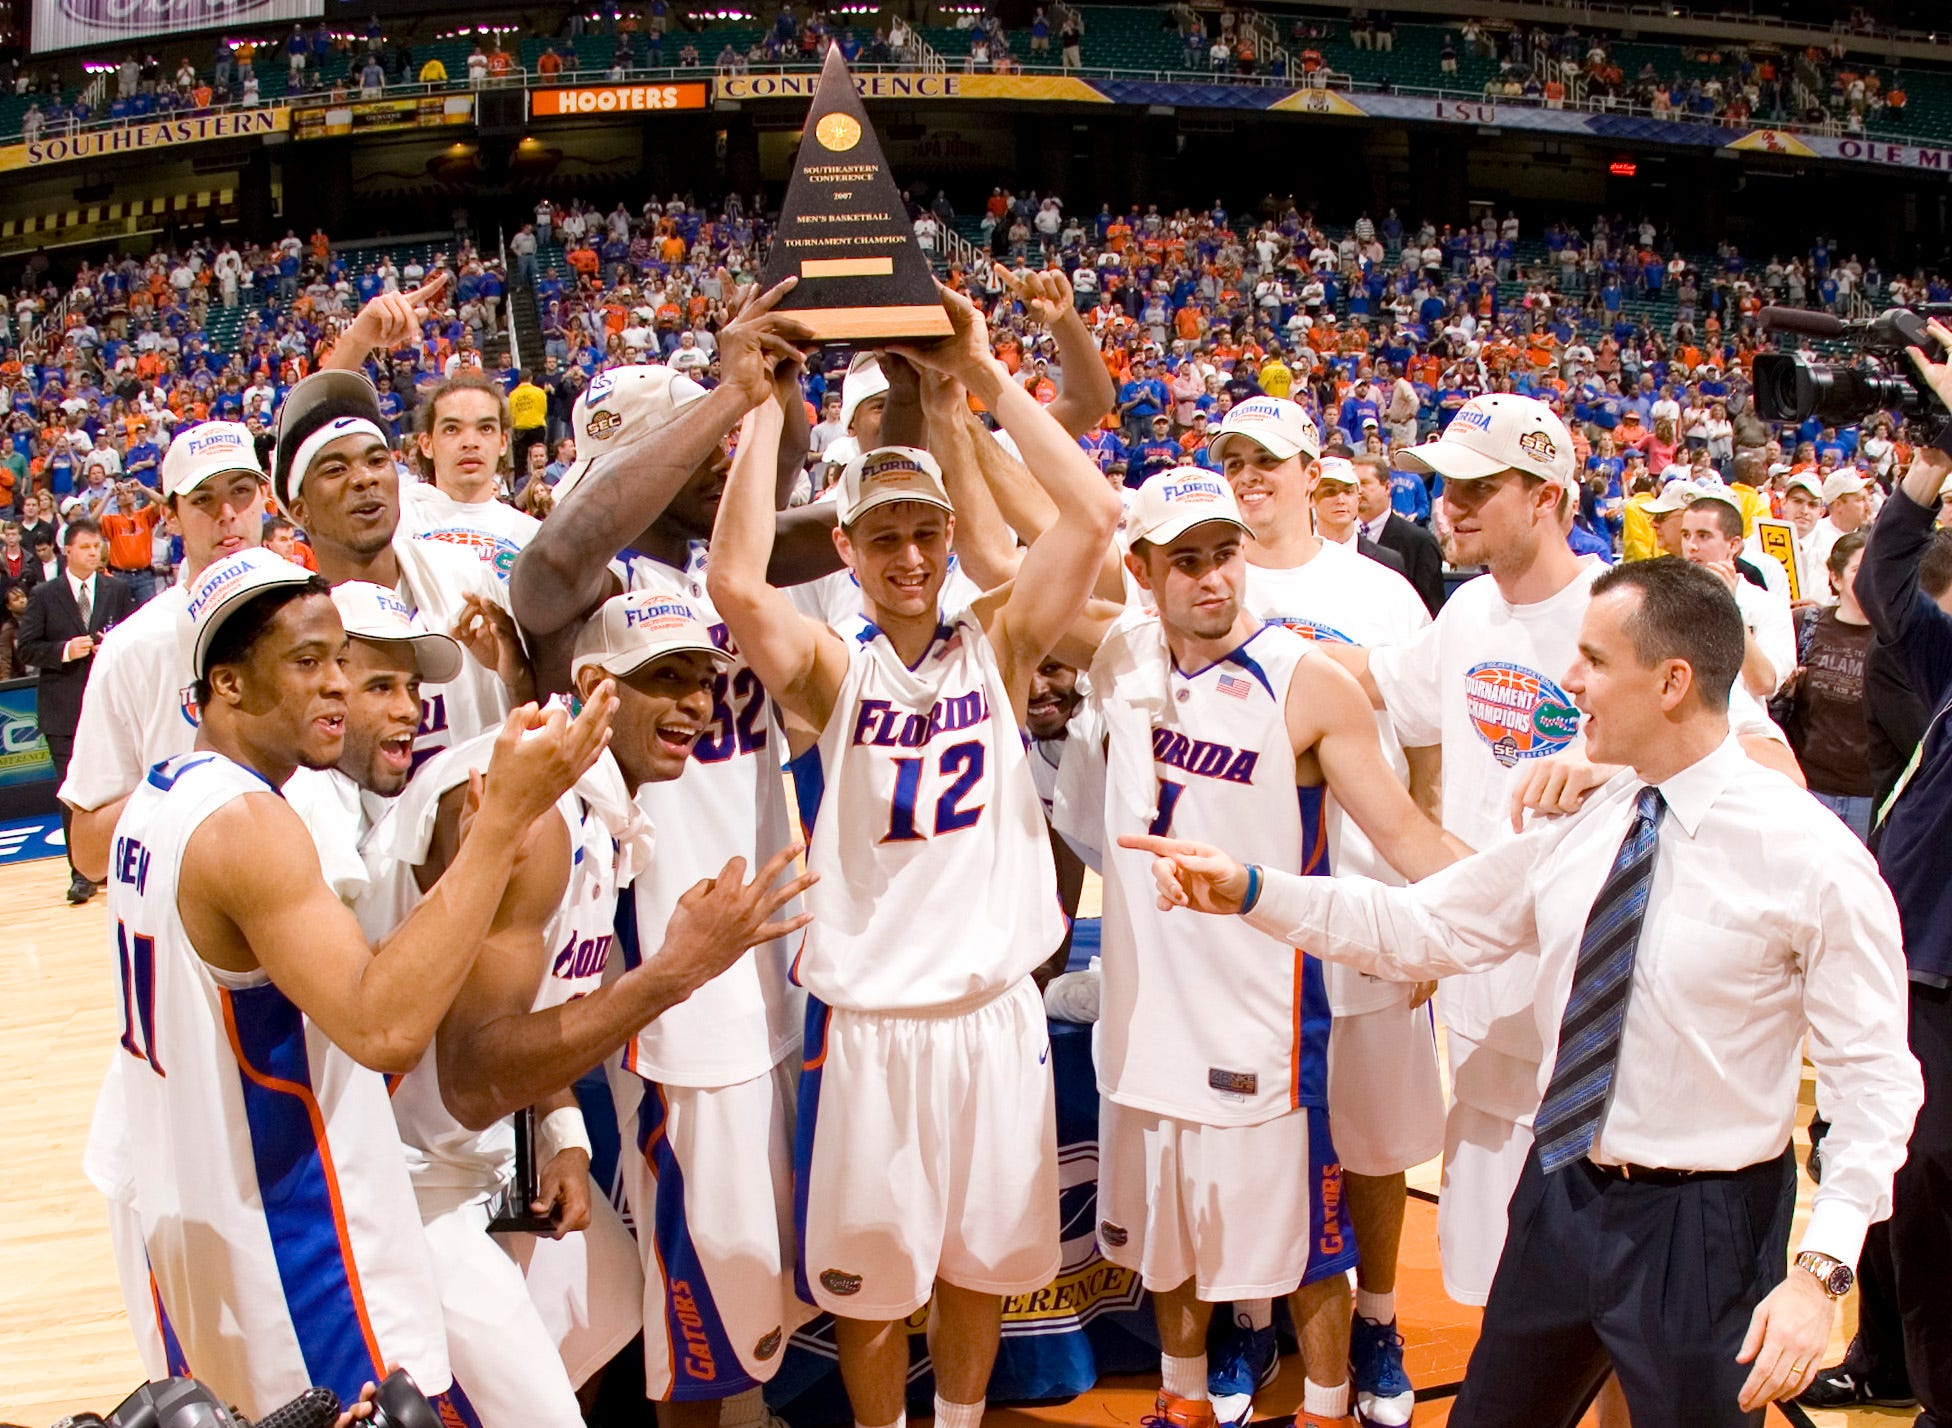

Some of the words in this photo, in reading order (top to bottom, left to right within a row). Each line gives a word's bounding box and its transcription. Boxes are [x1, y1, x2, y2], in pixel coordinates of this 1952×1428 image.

[725, 76, 960, 98] CONFRENCE
[558, 87, 678, 113] HOOTERS
[1435, 101, 1495, 123] LSU
[28, 111, 274, 164] SOUTHEASTERN
[1838, 141, 1902, 163] OLE
[803, 165, 879, 174] SOUTHEASTERN
[809, 174, 873, 182] CONFERENCE
[833, 192, 852, 200] 2007
[797, 215, 827, 223] MEN'S
[828, 213, 891, 222] BASKETBALL
[784, 238, 852, 247] TOURNAMENT
[853, 236, 906, 245] CHAMPION
[588, 413, 621, 435] SEC
[1228, 404, 1281, 423] FLORIDA
[188, 434, 245, 456] FLORIDA
[1521, 434, 1556, 457] SEC
[861, 460, 927, 482] FLORIDA
[1163, 482, 1226, 502] FLORIDA
[188, 561, 256, 623] FLORIDA
[624, 604, 697, 629] FLORIDA
[691, 667, 768, 765] 32
[878, 739, 986, 844] 12
[116, 912, 166, 1078] 11
[1319, 1163, 1344, 1254] GATORS
[671, 1279, 716, 1381] GATORS
